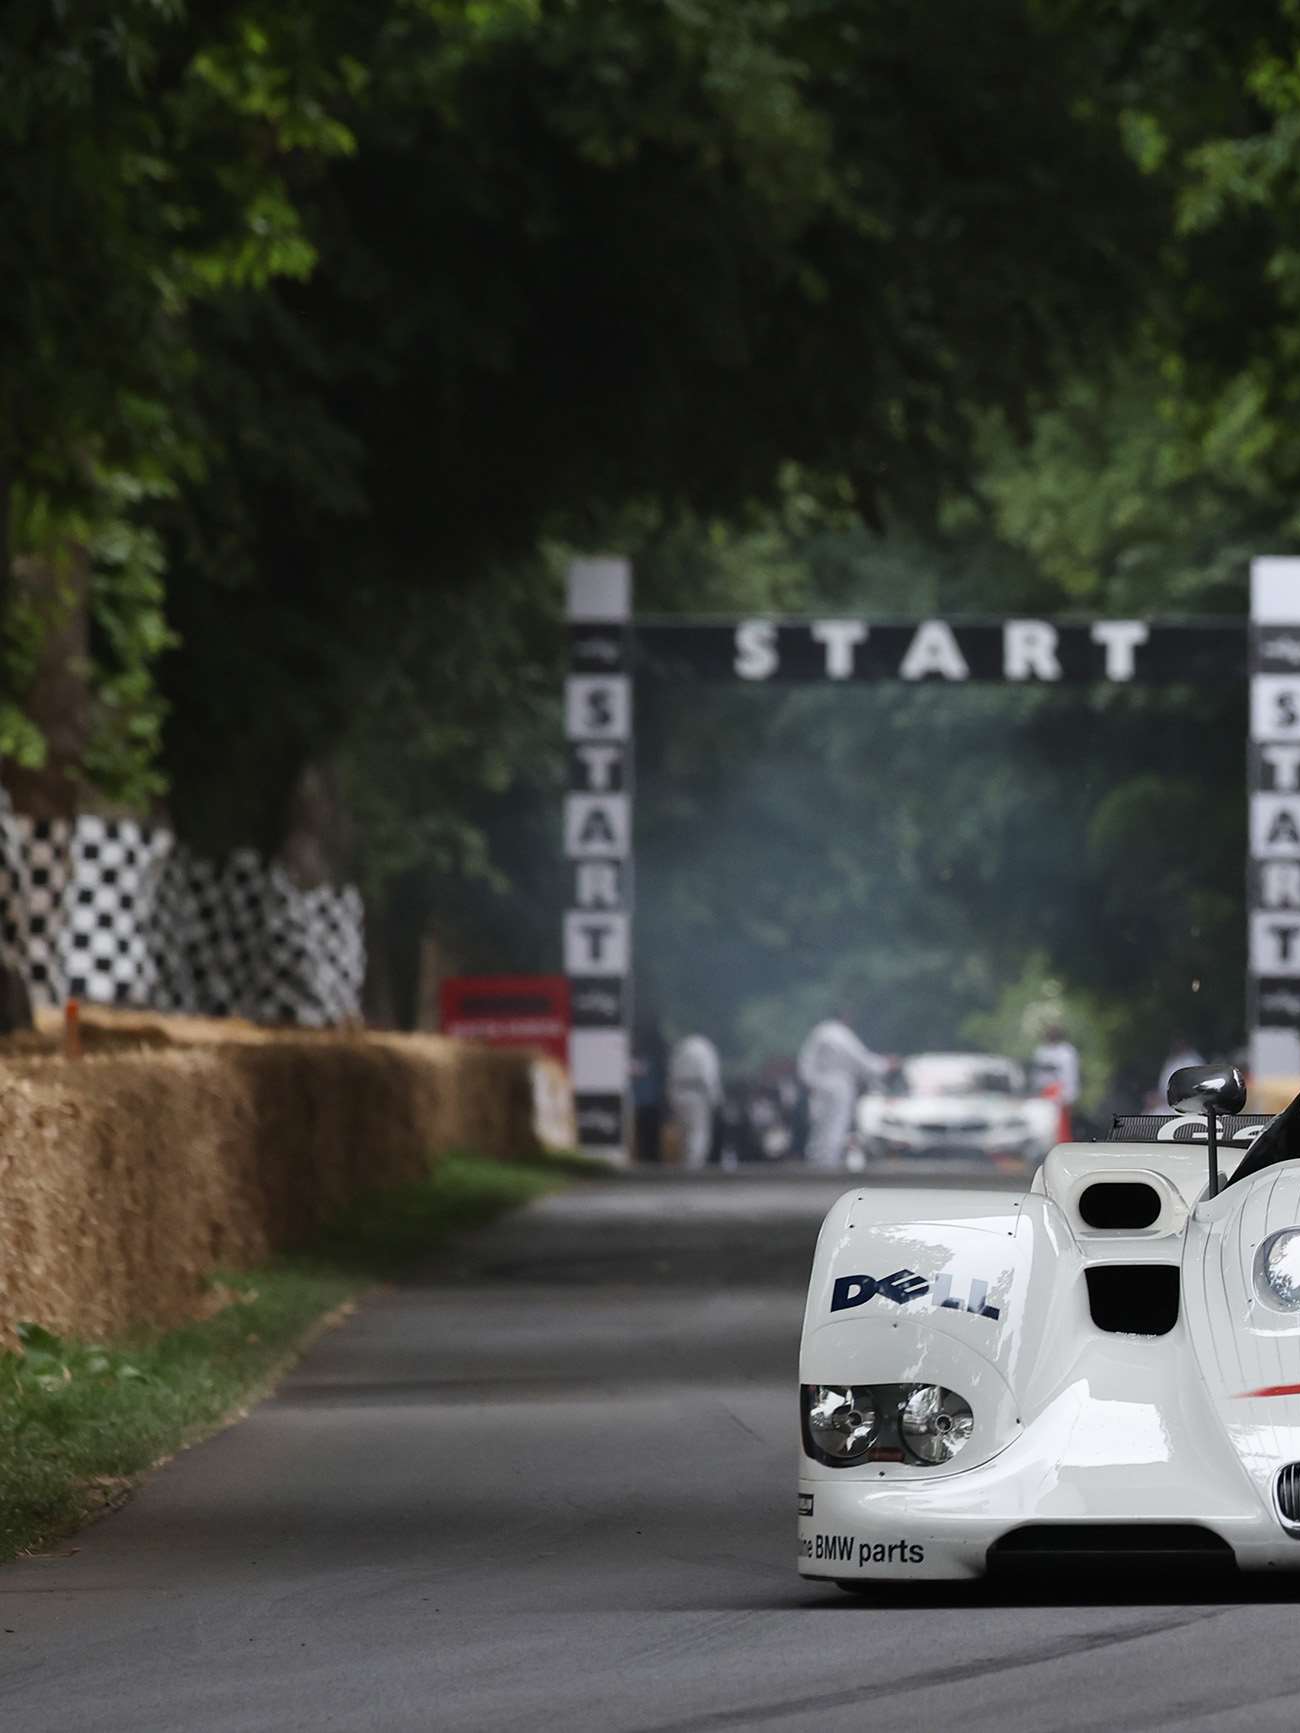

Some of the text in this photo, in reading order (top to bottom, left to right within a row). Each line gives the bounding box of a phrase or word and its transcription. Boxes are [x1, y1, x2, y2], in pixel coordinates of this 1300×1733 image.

[732, 619, 1148, 682] START
[577, 689, 621, 962] START
[831, 1268, 999, 1320] DELL
[816, 1534, 855, 1560] BMW
[859, 1539, 924, 1567] parts
